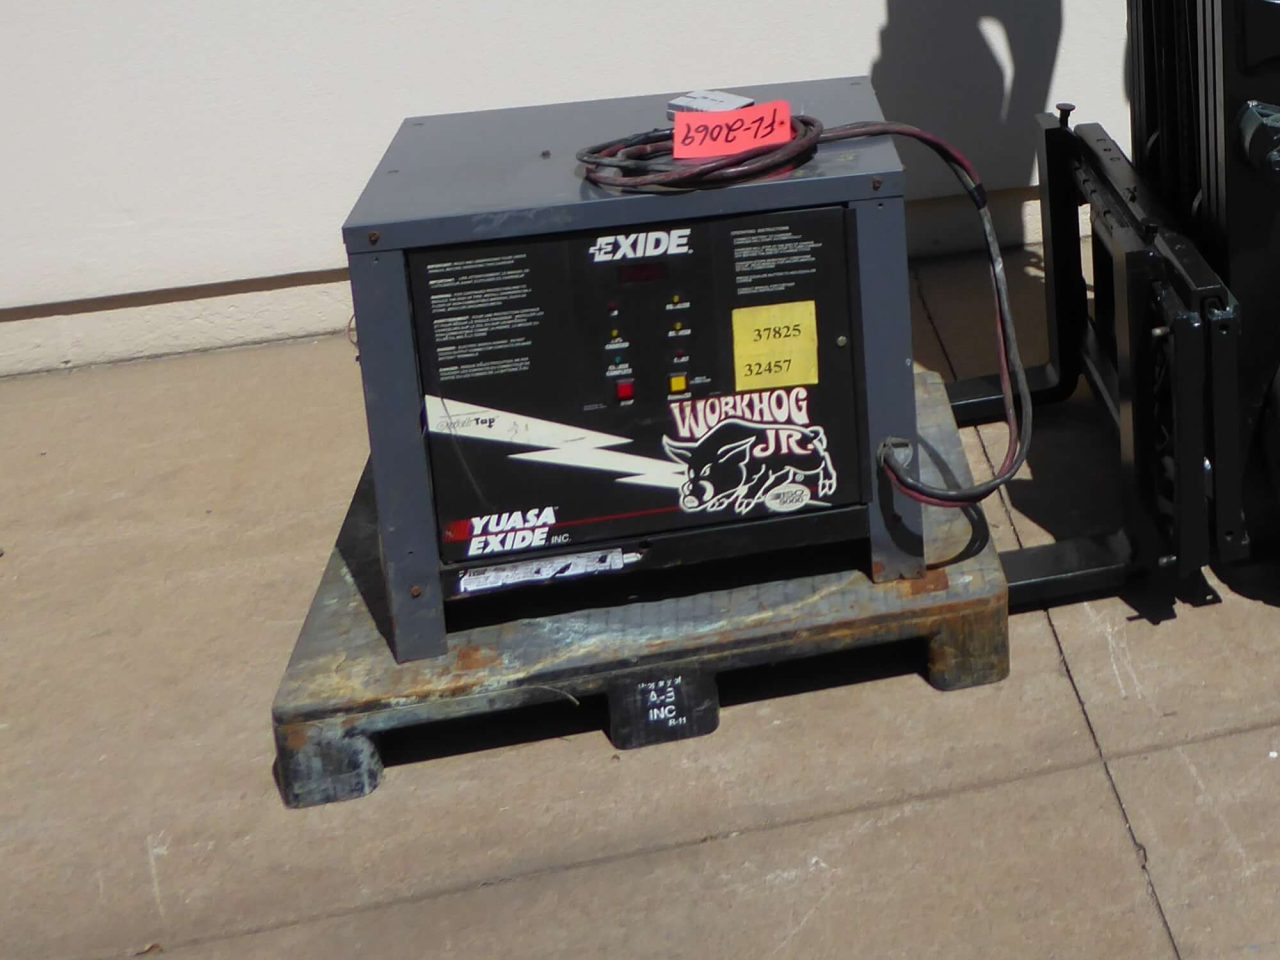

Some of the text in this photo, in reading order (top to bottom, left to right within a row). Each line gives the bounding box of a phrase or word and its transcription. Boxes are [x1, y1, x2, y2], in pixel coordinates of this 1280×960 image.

[681, 108, 778, 147] FL-2069
[589, 228, 692, 262] EXIDE
[753, 324, 801, 343] 37825
[744, 359, 792, 377] 32457
[670, 387, 810, 438] WORKHOG
[753, 429, 815, 457] JR.
[471, 506, 556, 536] YUASA
[468, 527, 572, 557] EXIDE INC.
[648, 705, 676, 721] INC
[668, 716, 687, 727] R-11
